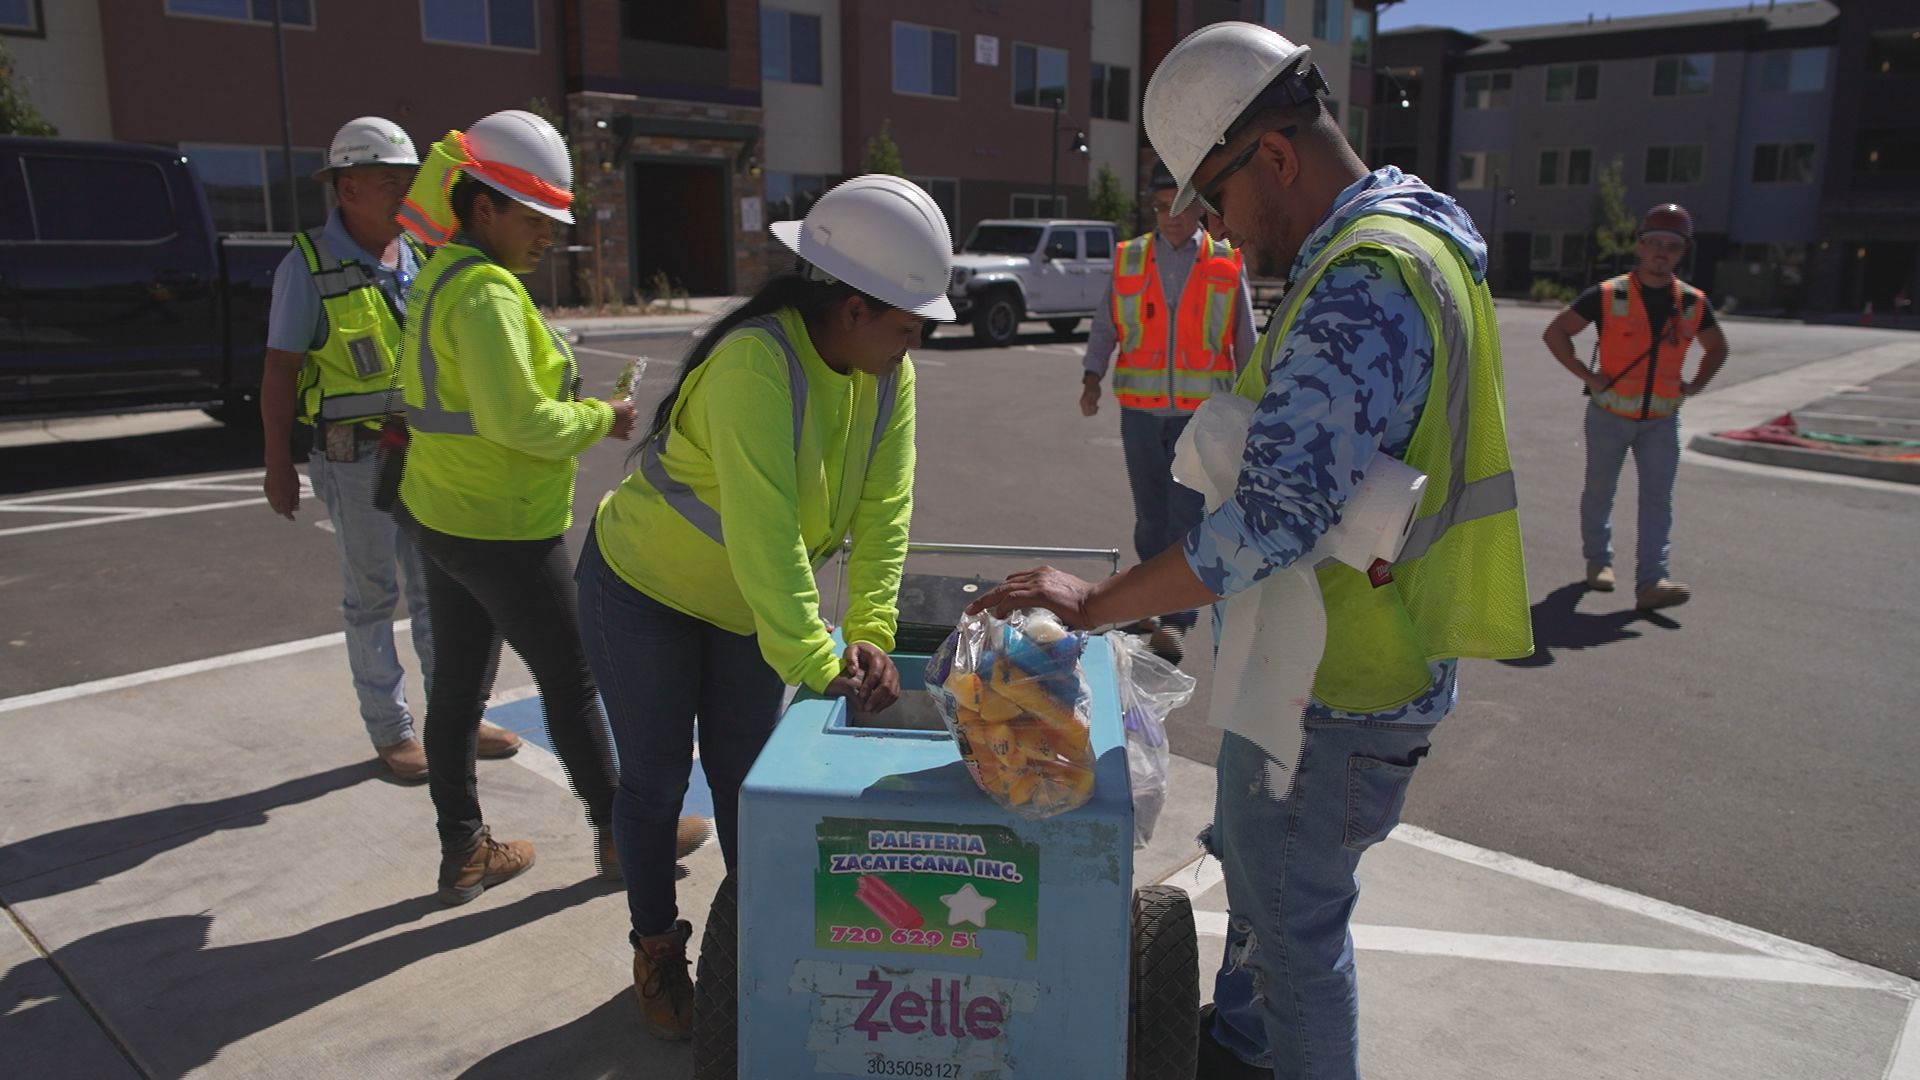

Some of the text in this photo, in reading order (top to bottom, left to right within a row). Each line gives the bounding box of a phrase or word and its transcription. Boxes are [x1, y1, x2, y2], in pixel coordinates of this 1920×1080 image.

[869, 830, 986, 855] PALETERIA
[830, 854, 1023, 882] ZACATECANA INC.
[831, 926, 883, 944] 720
[890, 928, 943, 947] 629
[854, 970, 1004, 1041] Zelle
[867, 1059, 962, 1079] 3035058127
